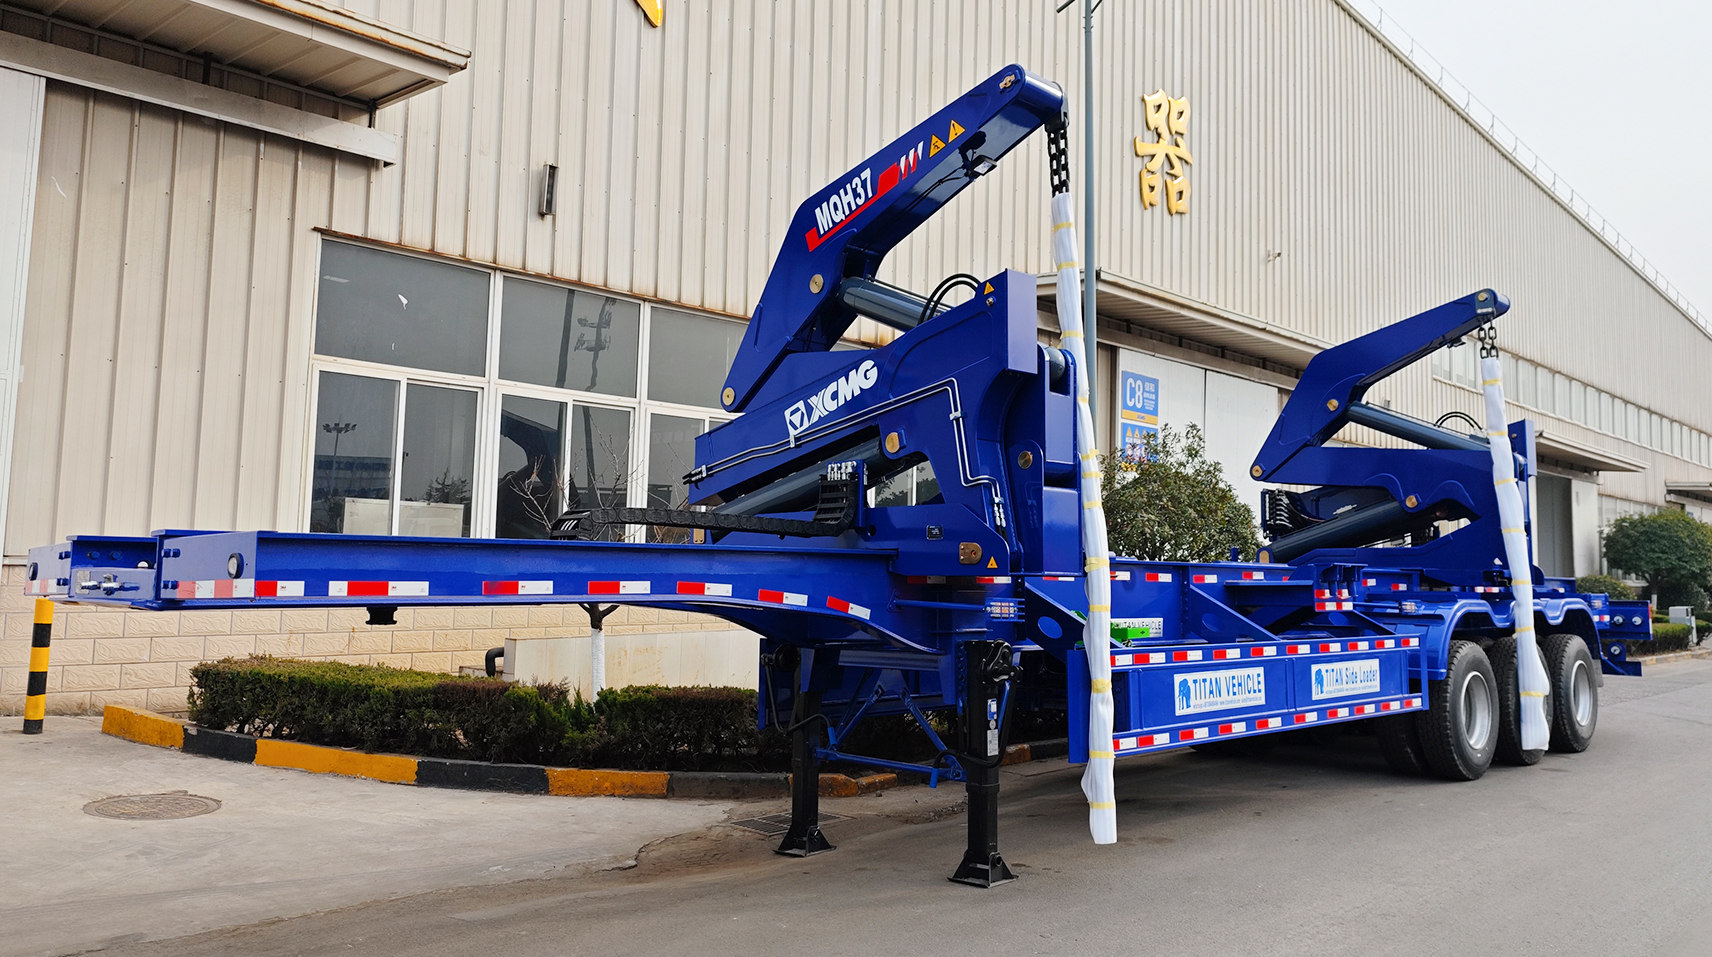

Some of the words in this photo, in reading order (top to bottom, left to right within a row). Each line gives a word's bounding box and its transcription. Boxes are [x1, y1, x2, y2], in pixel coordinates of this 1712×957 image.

[1134, 88, 1193, 216] 器
[814, 167, 873, 235] MQH37
[807, 359, 878, 424] XCMG
[1126, 377, 1143, 409] C8
[1192, 677, 1222, 700] TITAN
[1224, 672, 1262, 696] VEHICLE
[1325, 667, 1344, 687] TITAN
[1345, 666, 1358, 685] Side
[1360, 664, 1378, 683] Loader
